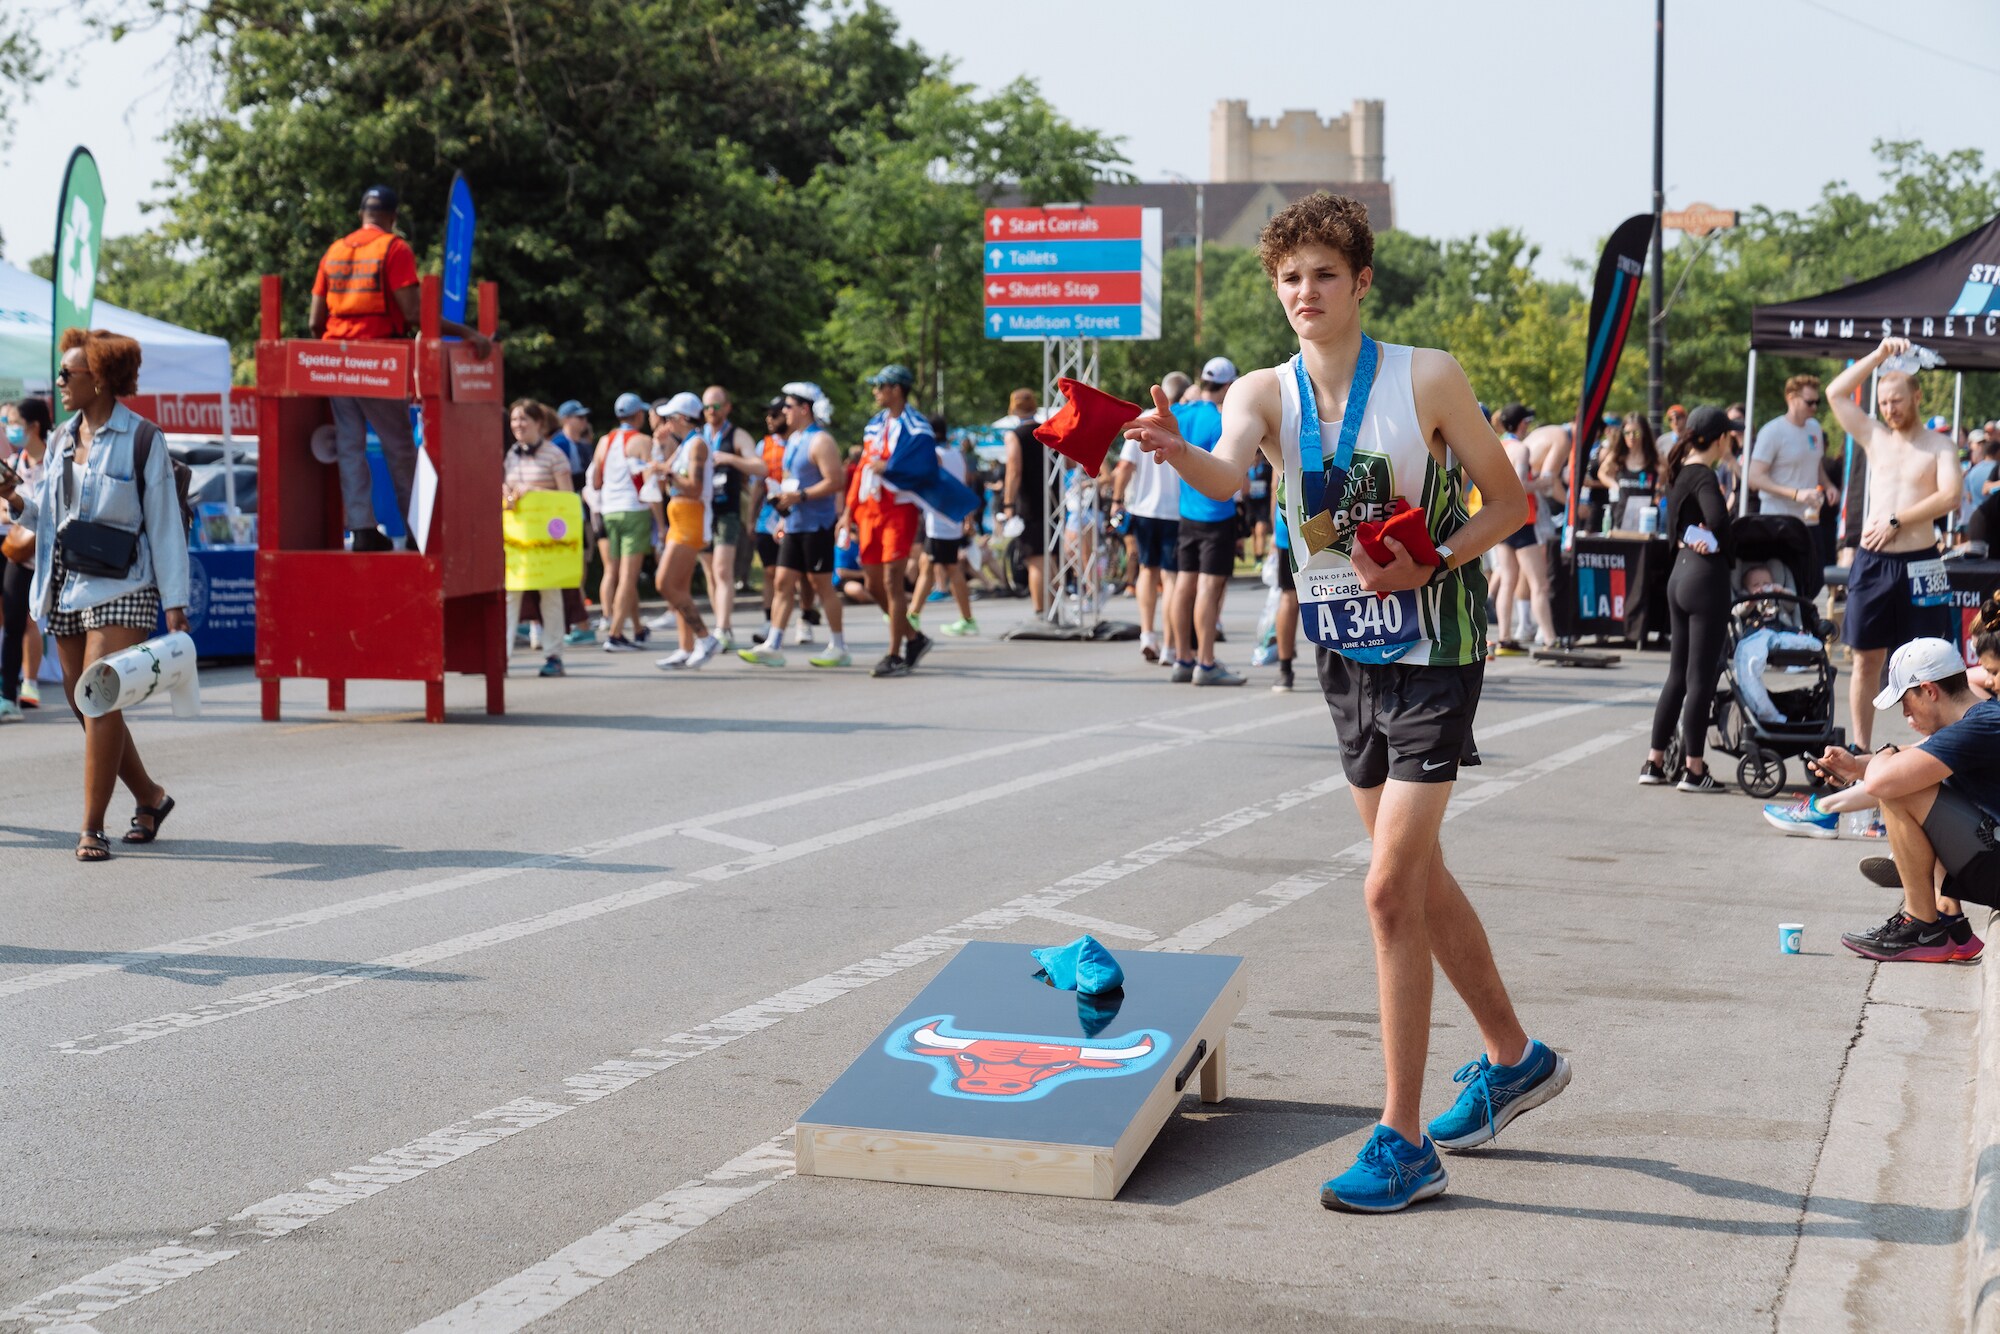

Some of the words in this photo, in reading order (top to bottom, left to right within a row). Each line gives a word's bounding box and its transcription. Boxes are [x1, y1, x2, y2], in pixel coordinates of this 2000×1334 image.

[1009, 217, 1045, 234] Start
[1048, 216, 1099, 233] Corrals
[1009, 250, 1058, 266] Toilets
[1008, 281, 1061, 298] Shuttle
[1064, 280, 1099, 300] Stop
[1009, 315, 1071, 330] Madison
[1074, 313, 1120, 330] Street
[298, 351, 341, 368] Spotter
[345, 355, 379, 370] tower
[382, 357, 397, 371] #3
[310, 370, 337, 383] South
[338, 372, 360, 385] Field
[361, 374, 389, 387] House
[1577, 552, 1625, 569] STRETCH
[1913, 575, 1923, 595] A
[1583, 594, 1624, 618] LAB
[1317, 603, 1340, 641] A
[1344, 594, 1402, 639] 340
[1342, 641, 1359, 650] JUNE
[1368, 638, 1385, 647] 2023
